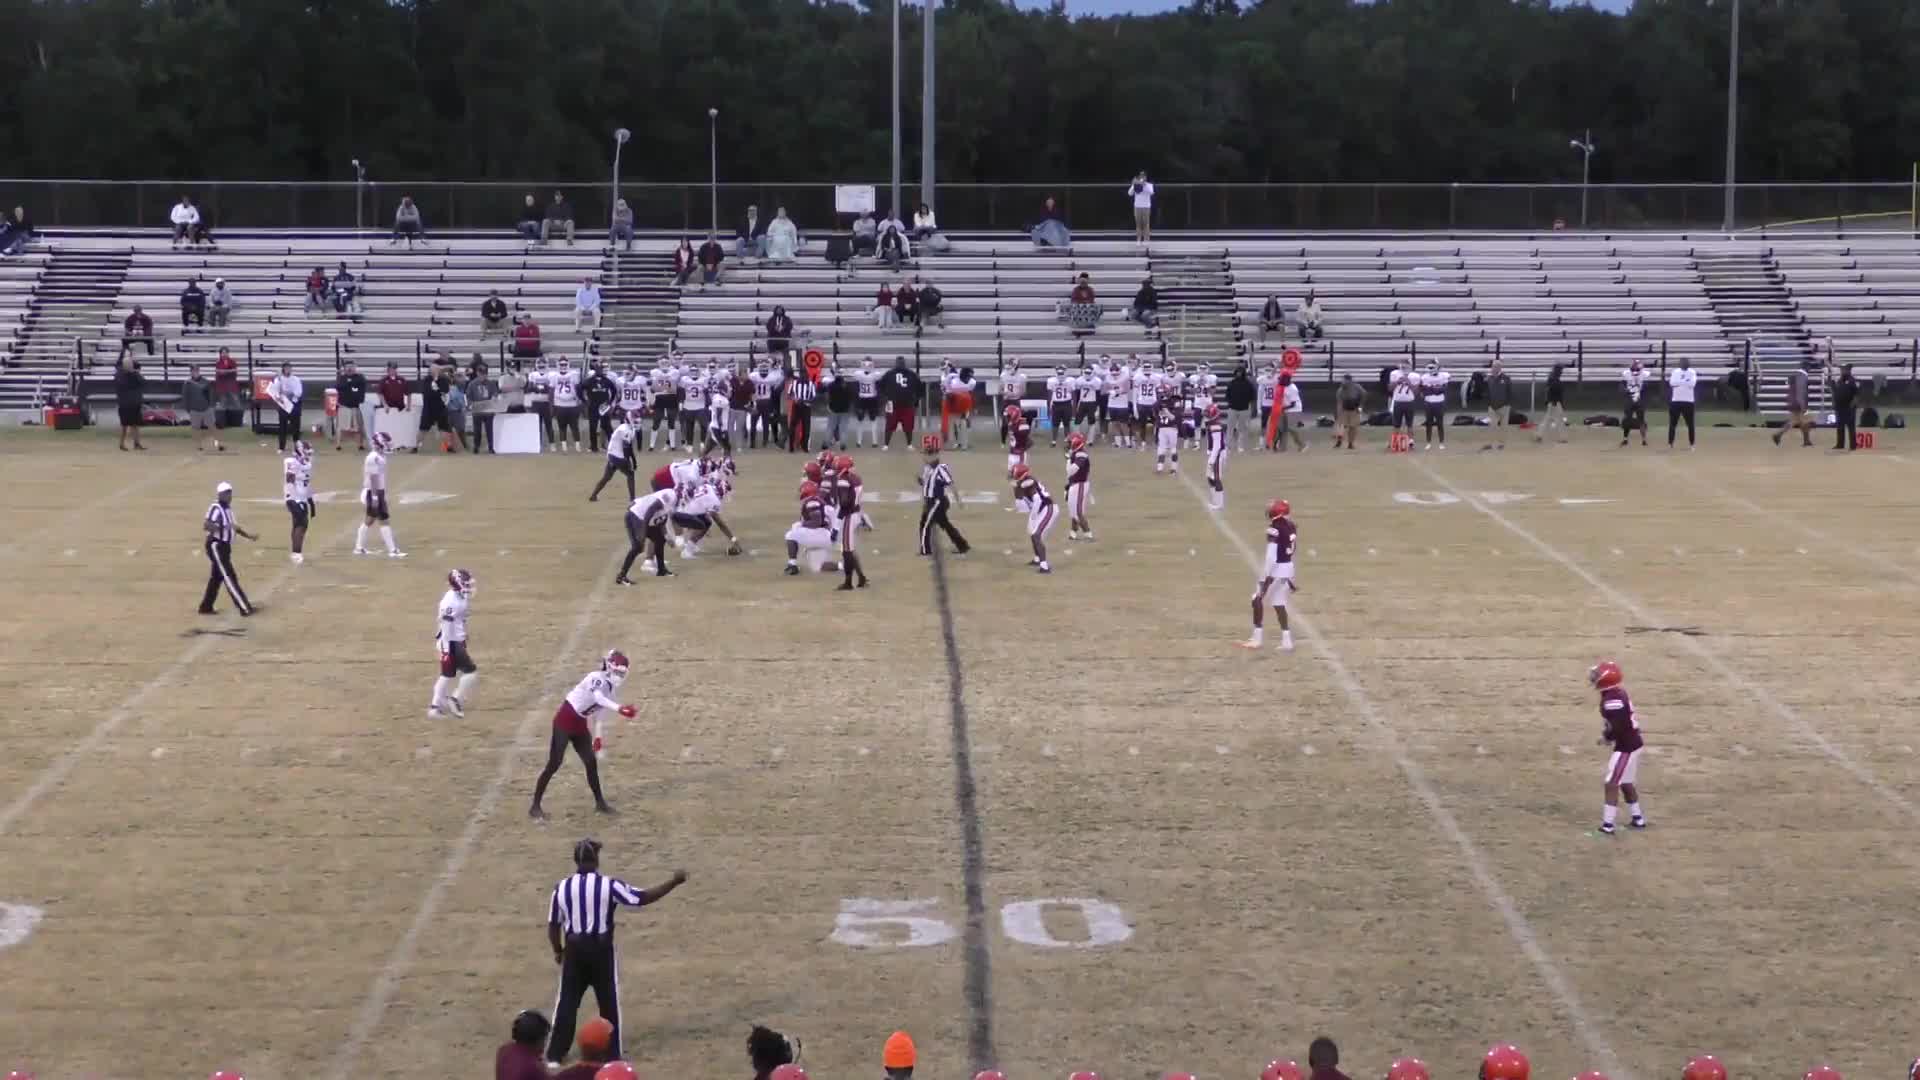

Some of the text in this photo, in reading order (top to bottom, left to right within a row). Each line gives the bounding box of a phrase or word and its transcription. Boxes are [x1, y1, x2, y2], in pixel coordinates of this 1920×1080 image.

[558, 382, 572, 394] 75
[690, 386, 700, 399] 3
[1055, 387, 1068, 399] 61
[1083, 387, 1091, 399] 7
[1141, 384, 1154, 397] 82
[831, 897, 1131, 948] 50
